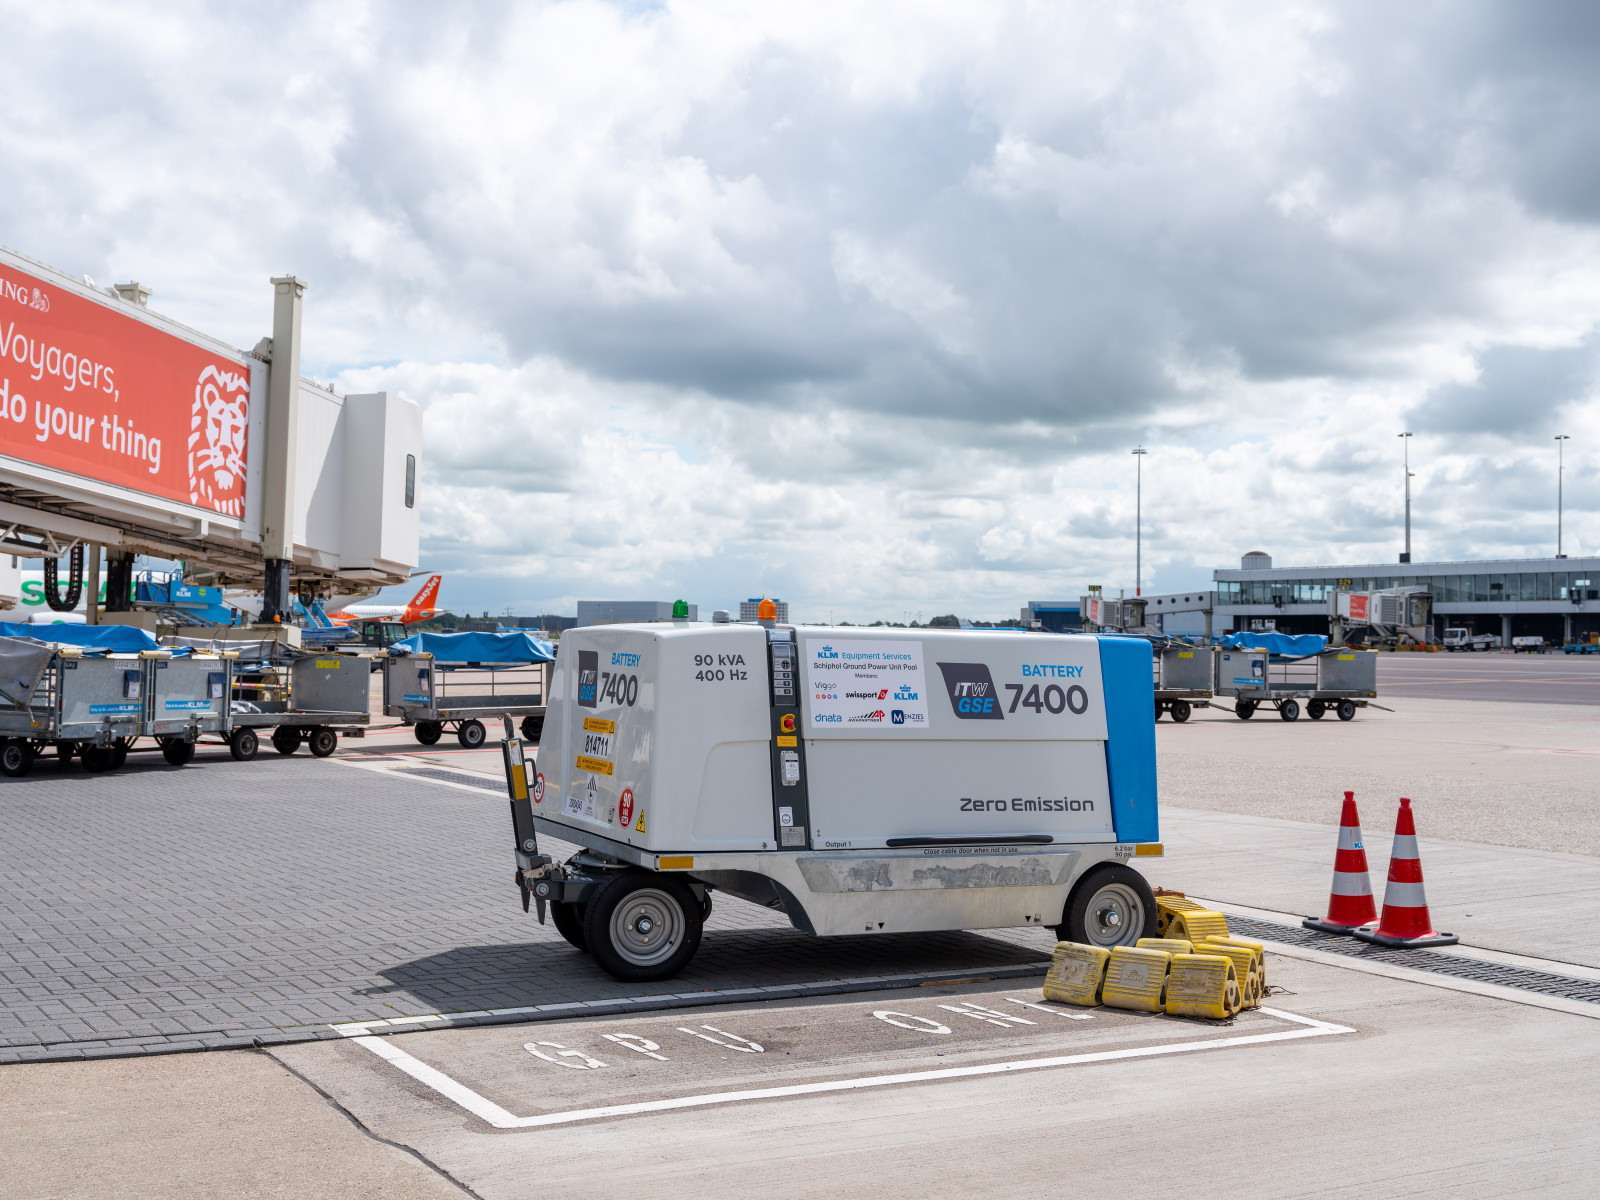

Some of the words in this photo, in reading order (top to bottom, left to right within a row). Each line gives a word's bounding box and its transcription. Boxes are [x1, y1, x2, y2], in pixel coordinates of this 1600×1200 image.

[0, 278, 28, 305] ING
[0, 321, 119, 403] Voyagers,
[0, 378, 27, 423] do
[35, 400, 95, 443] your
[101, 414, 161, 474] thing
[415, 576, 440, 605] easyJet
[611, 652, 641, 667] BATTERY
[694, 655, 714, 666] 90
[719, 654, 746, 666] kVA
[817, 651, 839, 659] KLM
[842, 652, 880, 661] Equipment
[882, 653, 912, 661] Services
[813, 662, 842, 671] Schiphol
[1022, 664, 1084, 678] BATTERY
[580, 670, 597, 685] ITW
[695, 670, 725, 682] 400
[729, 669, 748, 682] Hz
[580, 685, 596, 701] GSE
[599, 672, 638, 707] 7400
[845, 691, 878, 700] swissport
[893, 692, 919, 700] KLM
[954, 681, 989, 697] ITW
[958, 697, 995, 713] GSE
[1005, 683, 1089, 714] 7400
[815, 713, 842, 723] dnata
[585, 734, 609, 757] 814711
[623, 792, 631, 808] 90
[960, 797, 1007, 812] Zero
[1011, 796, 1095, 812] Emission
[1123, 973, 1144, 981] KLM
[872, 997, 1096, 1035] ONL
[523, 1024, 765, 1071] GPU
